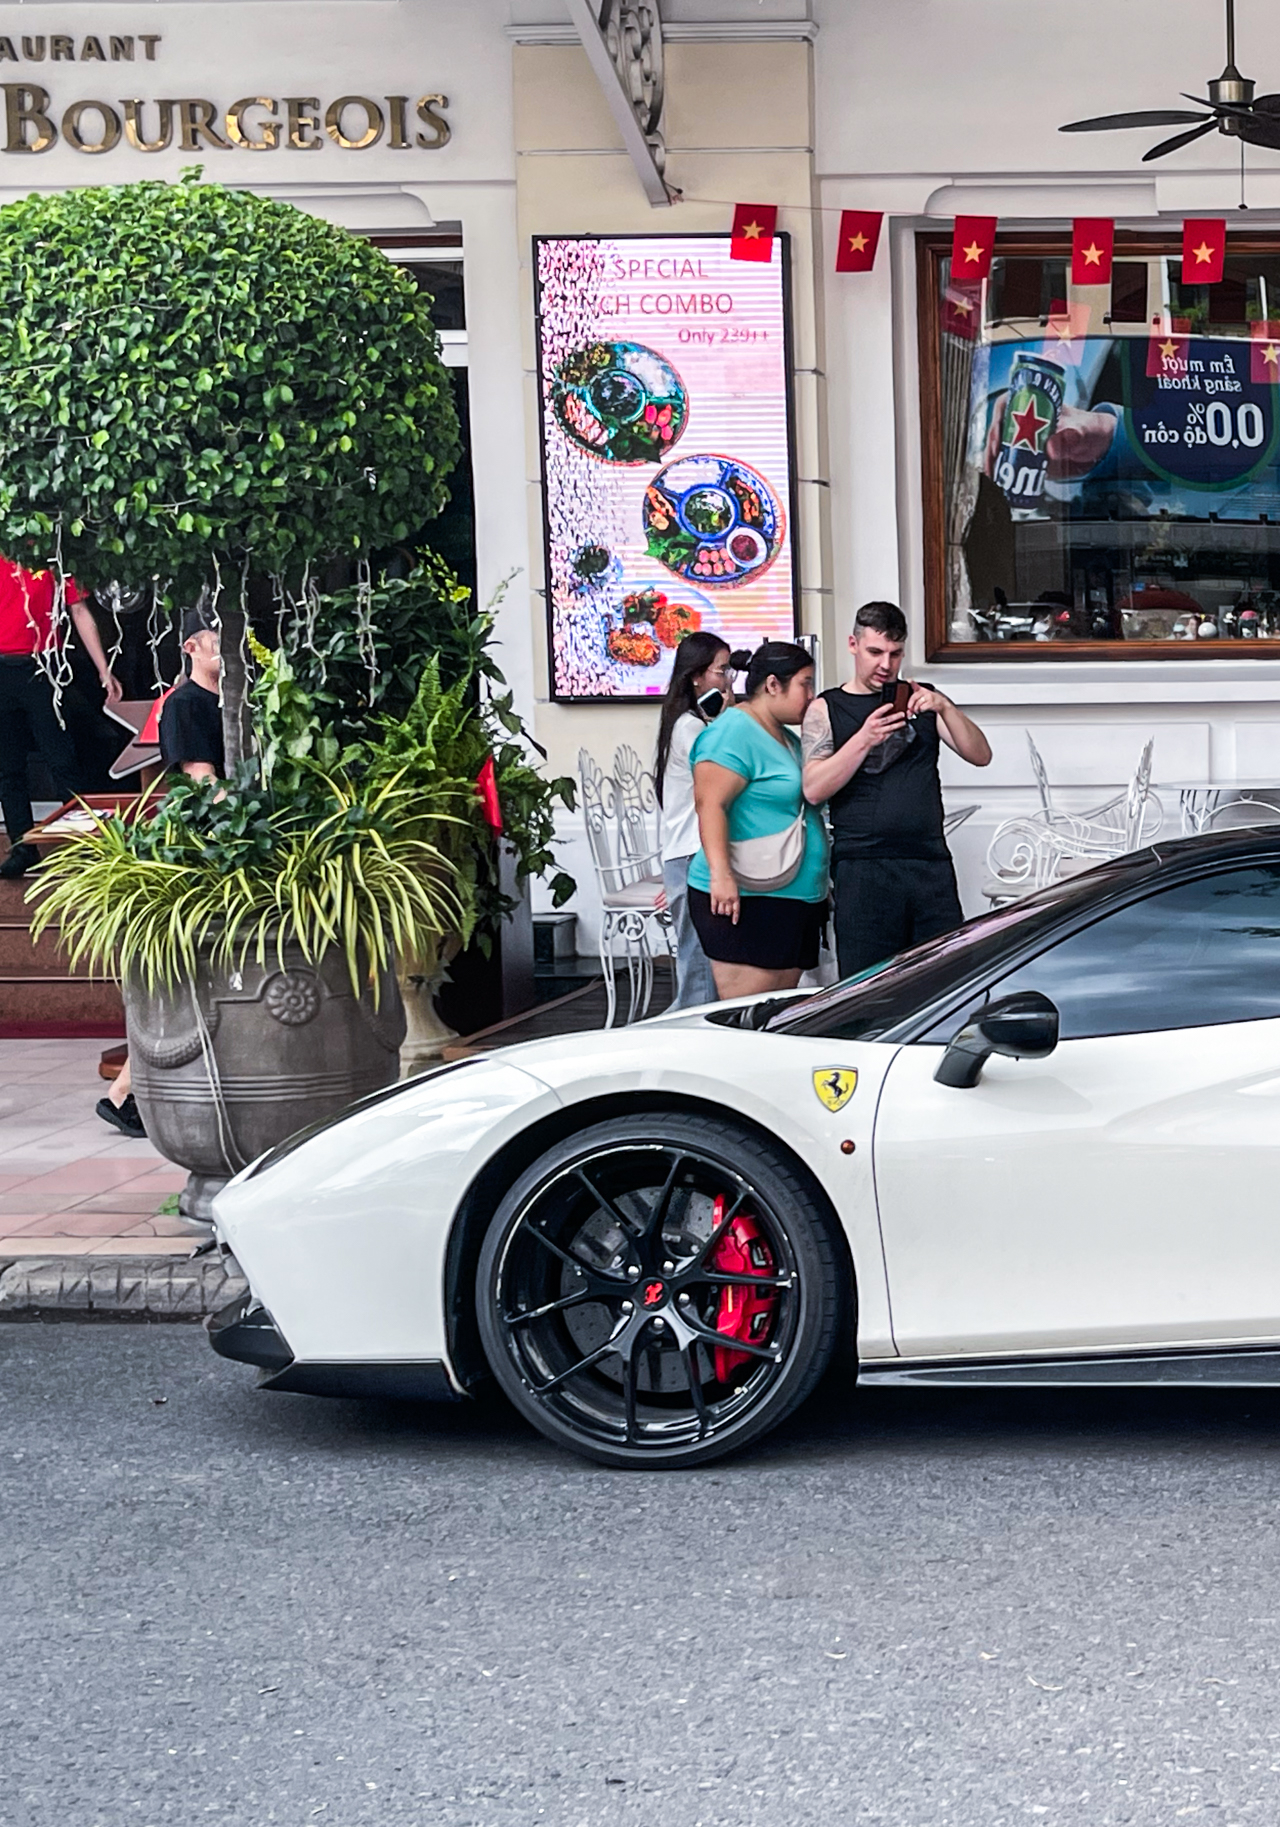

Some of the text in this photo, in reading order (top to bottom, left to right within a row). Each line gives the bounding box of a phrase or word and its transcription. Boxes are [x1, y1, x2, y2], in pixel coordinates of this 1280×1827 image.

[0, 35, 162, 62] AURANT
[0, 82, 451, 154] BOURGEOIS
[614, 259, 709, 280] SPECIAL
[640, 293, 733, 315] COMBO
[678, 328, 715, 345] Only
